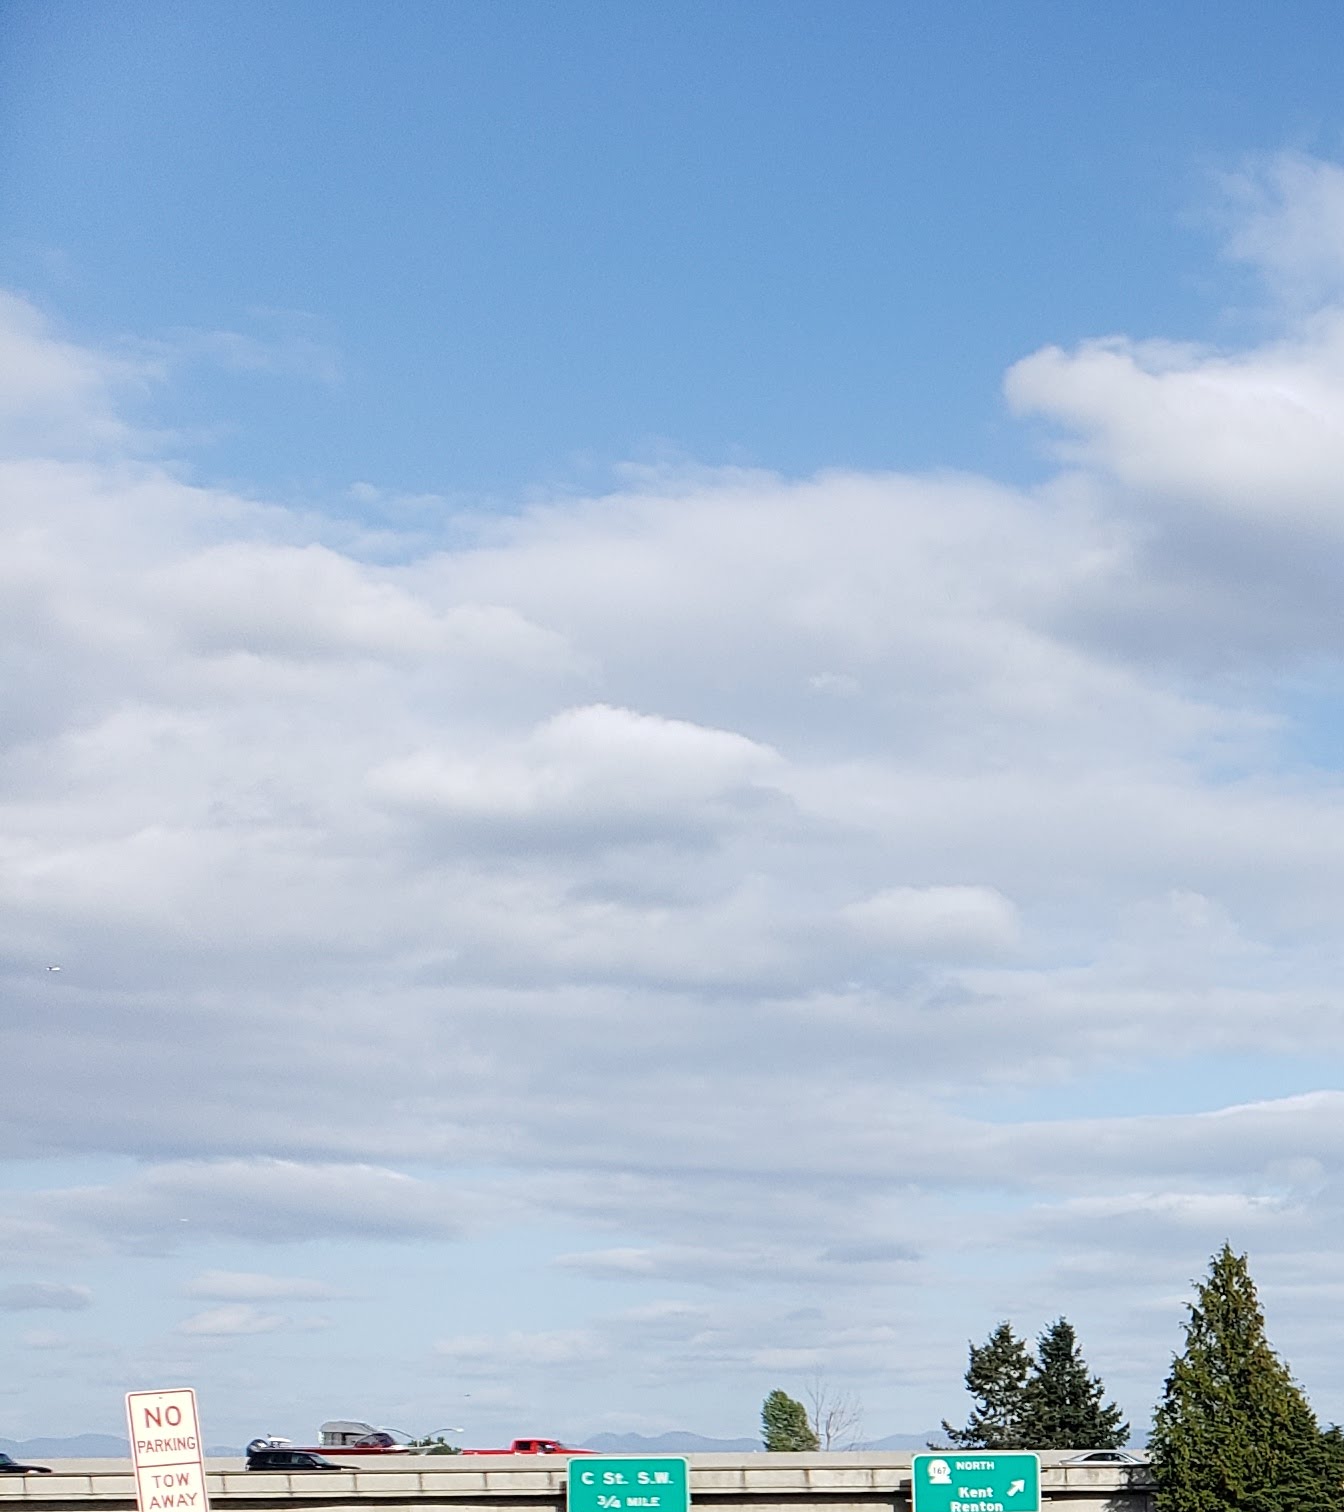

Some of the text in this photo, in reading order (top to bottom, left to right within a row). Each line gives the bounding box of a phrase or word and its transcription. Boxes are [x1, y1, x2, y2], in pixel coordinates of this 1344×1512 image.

[144, 1405, 182, 1428] NO
[137, 1436, 196, 1454] PARKING
[933, 1461, 995, 1475] 167 NORTH
[151, 1472, 190, 1489] TOW
[581, 1471, 675, 1485] C St. S.W.
[958, 1486, 994, 1499] Kent
[149, 1492, 198, 1510] AWAY
[626, 1496, 661, 1507] MILE
[950, 1501, 1004, 1512] Renton
